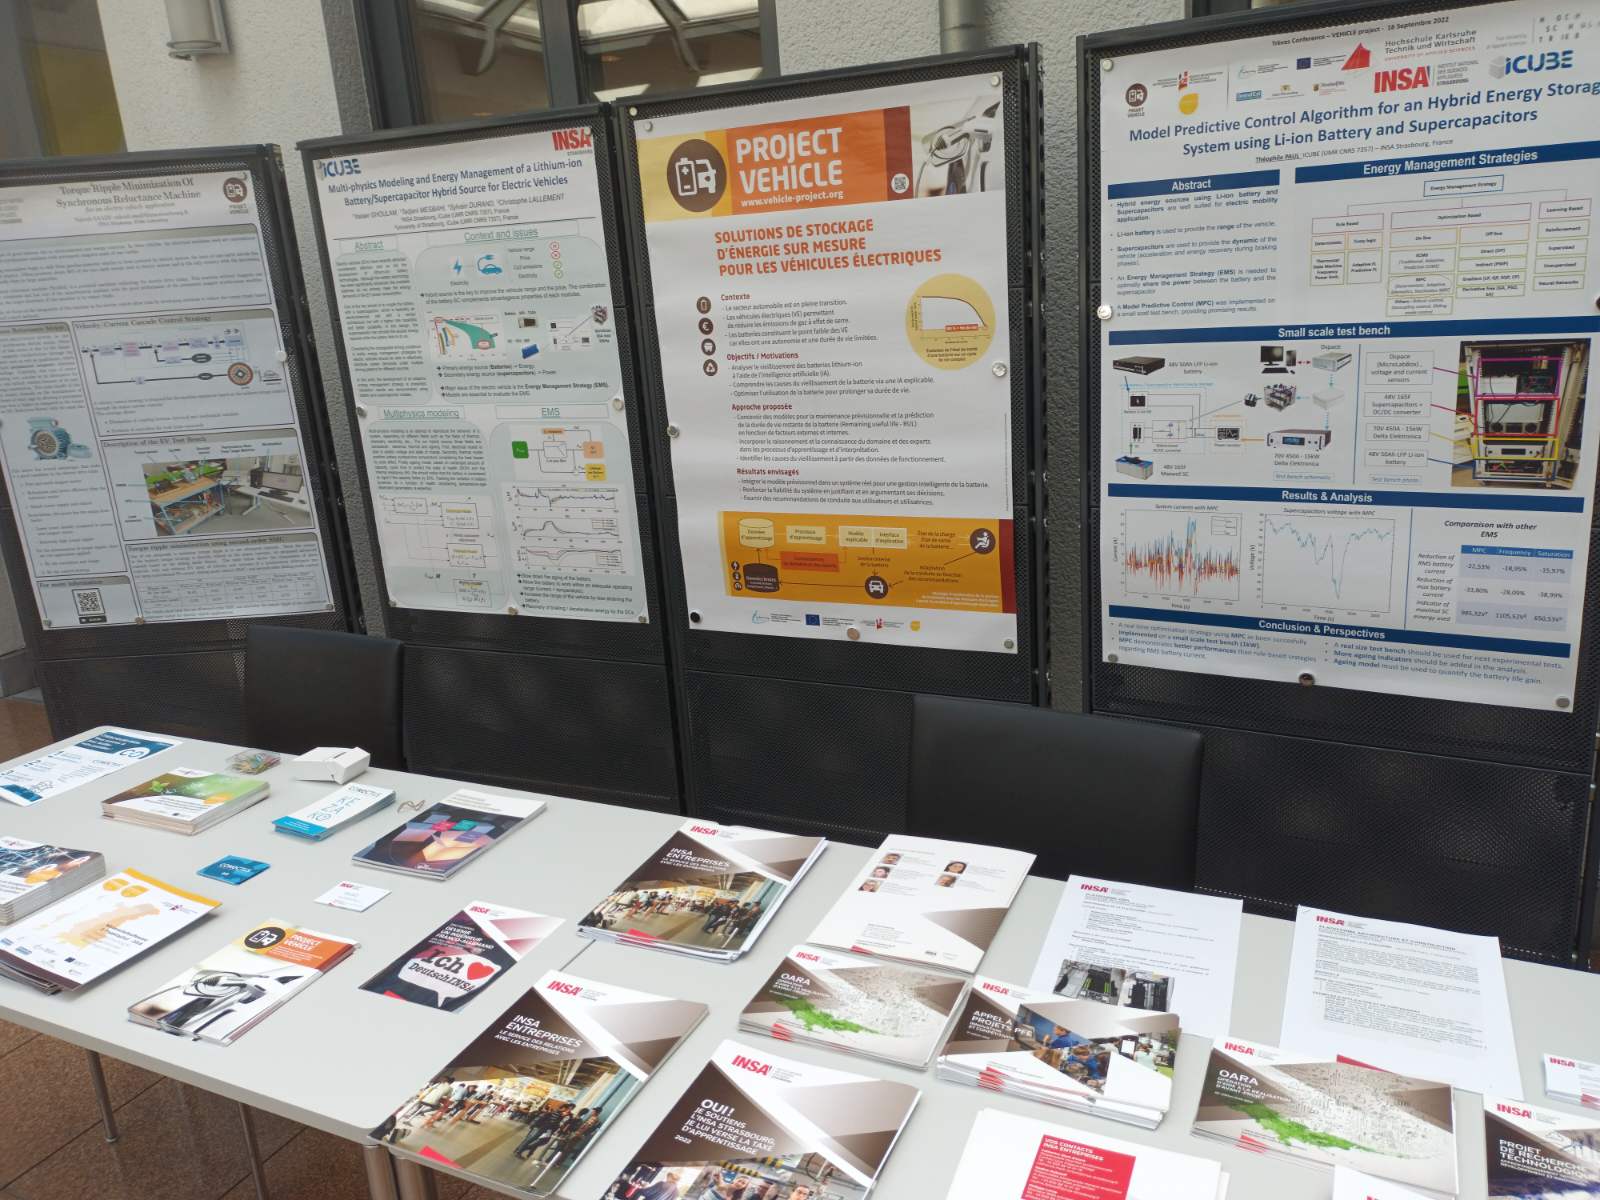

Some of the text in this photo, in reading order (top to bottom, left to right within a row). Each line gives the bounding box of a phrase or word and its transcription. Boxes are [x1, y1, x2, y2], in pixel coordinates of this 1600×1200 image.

[1331, 30, 1357, 38] VEHICLE
[1358, 26, 1380, 36] project
[1397, 20, 1431, 30] Septembre
[1386, 29, 1476, 47] Hochschule Karlsruhe
[1386, 37, 1475, 54] Technik und Wirtschaft
[1374, 66, 1430, 93] INSA
[1130, 126, 1170, 141] Model
[1174, 118, 1240, 136] Predictive
[1244, 112, 1296, 129] Control
[1300, 104, 1375, 126] Algorithm
[1378, 101, 1398, 115] for
[1404, 102, 1422, 112] an
[1428, 92, 1480, 113] Hybrid
[1486, 86, 1541, 107] Energy
[552, 128, 591, 151] INSA
[1183, 107, 1537, 158] System using Li-ion Battery and Supercapacitors
[736, 128, 842, 163] PROJECT
[1364, 162, 1402, 177] Energy
[1405, 157, 1475, 174] Management
[1478, 150, 1538, 167] Strategies
[329, 180, 377, 195] Multi-physics
[379, 176, 414, 190] Modeling
[416, 175, 430, 184] and
[432, 172, 458, 184] Energy
[460, 166, 514, 181] Management
[517, 165, 525, 173] of
[534, 159, 582, 172] Lithium-ion
[739, 160, 842, 194] VEHICLE
[345, 176, 567, 208] Battery/Supercapacitor Hybrid Source for Electric Vehicles
[1172, 179, 1211, 191] Abstract
[56, 191, 200, 208] Synchronous Reluctance Machine
[741, 191, 843, 208] www.vehicle-project.org
[464, 228, 537, 241] Context and issues
[715, 219, 873, 244] SOLUTIONS DE STOCKAGE
[355, 240, 383, 250] Abstract
[717, 237, 865, 260] D'ÉNERGIE SUR MESURE
[720, 248, 941, 276] POUR LES VÉHICULES ÉLECTRIQUES
[1279, 326, 1390, 337] Small scale test bench
[727, 353, 756, 362] Objectifs
[384, 409, 459, 419] Multiphysics modeling
[542, 407, 560, 417] EMS
[732, 403, 792, 412] Approche proposée
[768, 469, 799, 477] envisagés
[1282, 491, 1317, 501] Results
[1330, 492, 1372, 504] Analysis
[1259, 620, 1307, 633] Conclusion
[1324, 625, 1385, 641] Perspectives
[690, 825, 718, 836] INSA
[666, 852, 730, 867] ENTREPRISES
[670, 848, 692, 856] INSA
[1080, 883, 1108, 894] INSA
[470, 905, 490, 914] INSA
[1316, 915, 1345, 926] INSA
[422, 948, 464, 975] Ich
[796, 952, 820, 962] INSA
[781, 973, 810, 986] OARA
[547, 980, 583, 996] INSA
[982, 982, 1009, 996] INSA
[513, 1014, 540, 1028] INSA
[972, 1016, 1012, 1031] PROJETS
[974, 1010, 1004, 1023] APPEL
[506, 1022, 584, 1048] ENTREPRISES
[1224, 1042, 1255, 1056] INSA
[731, 1054, 770, 1076] INSA
[1550, 1056, 1576, 1068] INSA
[1219, 1069, 1258, 1086] OARA
[1496, 1103, 1532, 1120] INSA
[691, 1113, 716, 1127] L'INSA
[705, 1110, 746, 1129] SOUTIENS
[674, 1134, 692, 1144] 2022
[685, 1119, 774, 1152] JE LUI VERSE LA TAXE
[1500, 1140, 1541, 1155] PROJET
[1500, 1146, 1515, 1154] DE
